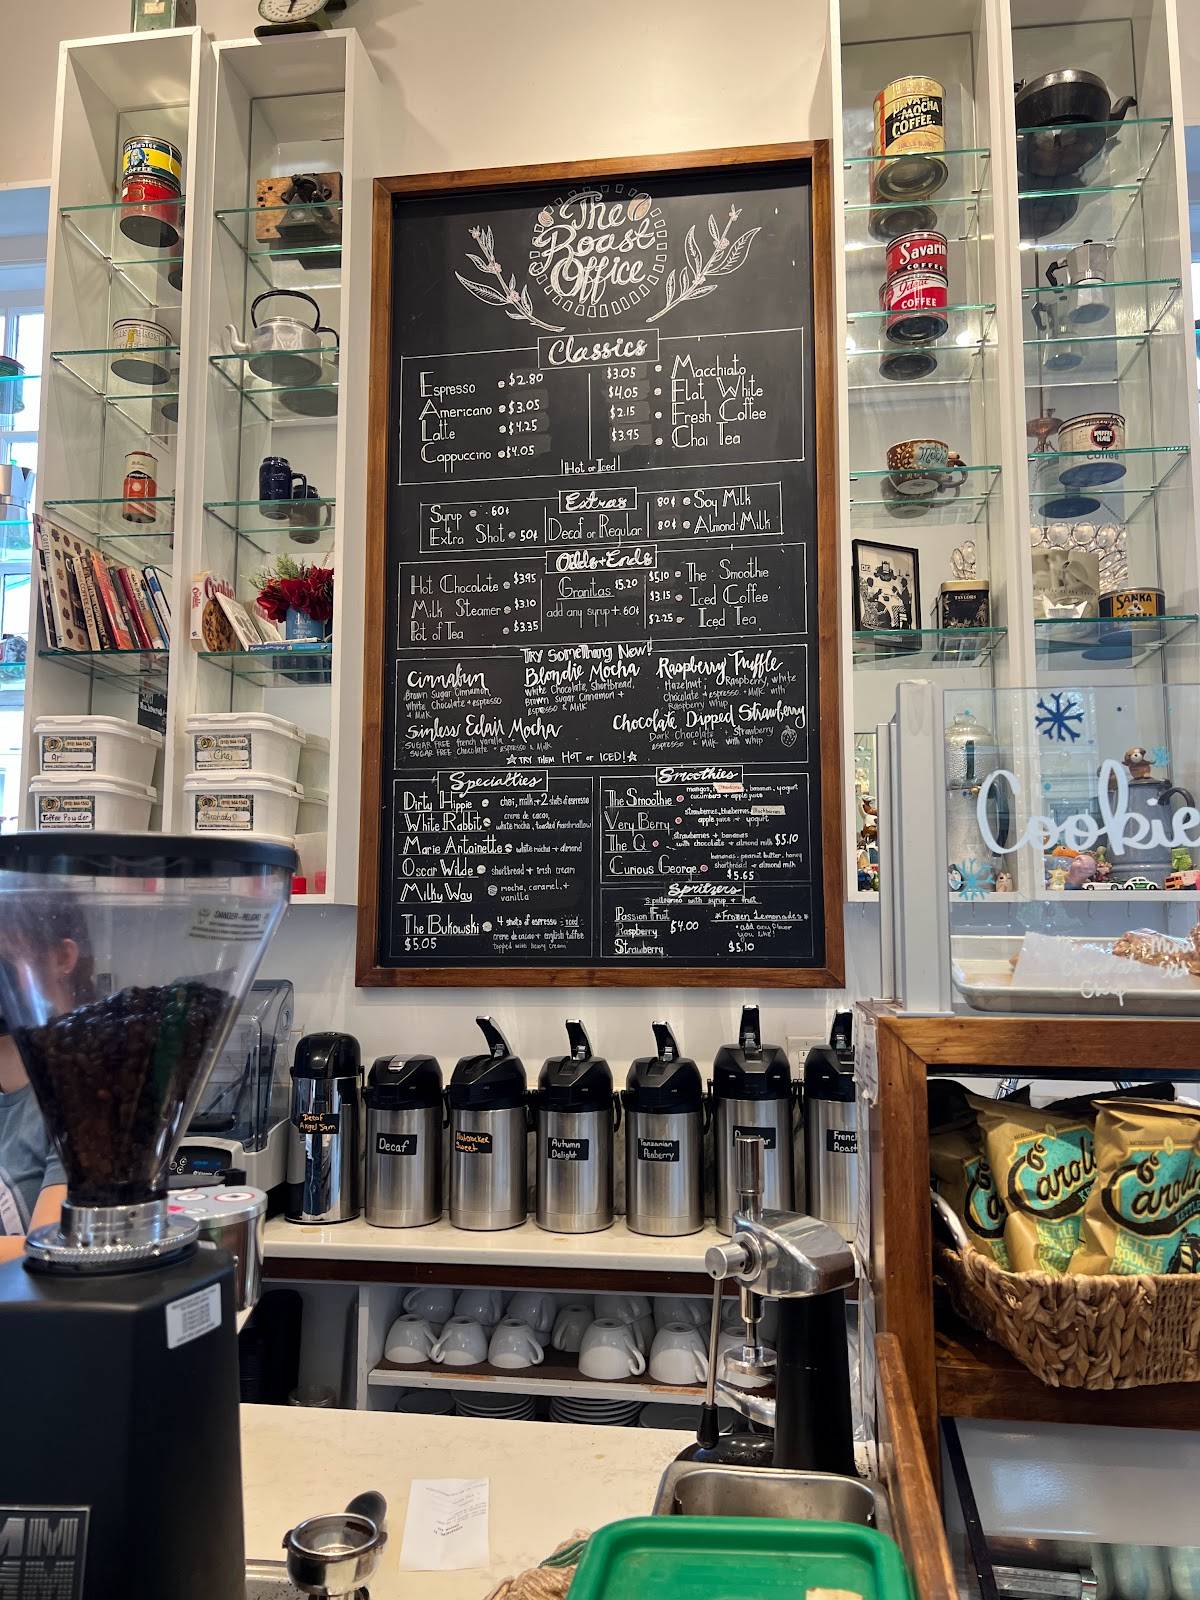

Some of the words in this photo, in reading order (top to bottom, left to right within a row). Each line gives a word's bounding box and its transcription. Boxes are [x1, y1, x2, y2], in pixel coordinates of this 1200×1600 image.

[901, 101, 939, 120] MOCHA
[560, 190, 626, 230] The
[530, 218, 658, 276] Roast
[900, 242, 946, 265] Savarin
[907, 263, 943, 271] COFFEE
[550, 254, 649, 304] Office
[901, 298, 937, 309] COFFEE
[548, 335, 648, 366] Classics
[606, 366, 636, 381] $3.05
[671, 353, 747, 379] Macchiato
[419, 371, 476, 403] Espresso
[509, 372, 543, 387] $2.80
[608, 386, 638, 399] $4.05
[671, 377, 705, 402] Flat
[716, 375, 764, 398] White
[419, 399, 493, 420] Americano
[508, 399, 540, 415] $3.05
[610, 405, 635, 420] $2.15
[671, 400, 712, 425] Fresh
[719, 397, 767, 422] Coffee
[421, 419, 456, 442] Latte
[509, 418, 538, 435] $4.25
[611, 428, 640, 442] $3.95
[671, 424, 708, 448] Chai
[716, 421, 741, 446] Tea
[421, 442, 492, 473] Cappuccino
[506, 445, 535, 459] $4.05
[565, 460, 585, 474] Hot
[596, 457, 616, 472] Iced
[565, 490, 628, 511] Extras
[694, 488, 718, 518] Soy
[722, 486, 751, 508] Milk
[430, 505, 463, 533] Syrup
[694, 512, 736, 534] Almond
[740, 510, 771, 531] Milk
[429, 526, 464, 546] Extra
[475, 523, 505, 544] Shot
[548, 517, 584, 541] Decaf
[586, 530, 596, 538] or
[599, 513, 642, 547] Regular
[685, 562, 707, 582] The
[719, 556, 769, 580] Smoothie
[410, 574, 433, 595] Hot
[440, 573, 499, 594] Chocolate
[513, 572, 537, 585] $3.95
[558, 576, 612, 598] Granitas
[615, 578, 638, 591] $5.20
[650, 590, 671, 602] $3.15
[689, 584, 717, 607] Iced
[723, 583, 769, 605] Coffee
[1116, 593, 1152, 610] SANKA
[410, 599, 443, 619] Milk
[455, 598, 501, 618] Steamer
[514, 598, 537, 611] $3.10
[546, 602, 563, 618] add
[566, 608, 583, 628] any
[587, 606, 610, 628] syrup
[649, 613, 674, 625] $2.25
[698, 607, 726, 628] Iced
[734, 606, 757, 625] Tea
[410, 621, 427, 642] Pot
[432, 622, 442, 640] of
[444, 621, 464, 640] Tea
[514, 621, 539, 633] $3.35
[407, 663, 488, 690] Cinnabun
[524, 660, 584, 687] Blondie
[589, 660, 640, 682] Mocha
[656, 656, 727, 685] Raspberry
[728, 650, 783, 678] Truffle
[431, 697, 465, 710] Chocolate
[668, 700, 705, 711] Raspberry
[613, 708, 677, 732] Chocolate
[686, 705, 736, 731] Dipped
[738, 700, 806, 729] Strawberry
[405, 717, 461, 741] Sinless
[466, 714, 505, 737] Eclair
[508, 717, 563, 743] Mocha
[519, 756, 532, 764] TRY
[449, 771, 543, 798] Specialties
[658, 767, 739, 784] Smoothies
[403, 791, 433, 811] Dirty
[439, 790, 472, 812] Hippie
[540, 793, 548, 806] 2
[604, 789, 625, 807] The
[626, 787, 673, 806] Smoothie
[63, 813, 89, 822] Powder
[404, 813, 439, 832] White
[442, 812, 482, 831] Rabbit
[604, 811, 635, 835] Very
[638, 812, 670, 835] Berry
[403, 836, 441, 855] Marie
[445, 834, 503, 855] Antoinette
[605, 835, 627, 852] The
[633, 834, 646, 851] Q
[775, 834, 798, 846] $5.10
[402, 857, 437, 877] Oscar
[440, 857, 473, 877] Wilde
[610, 855, 654, 875] Curious
[727, 868, 754, 880] $5.65
[400, 882, 443, 903] Milky
[444, 882, 472, 903] Way
[668, 883, 742, 900] Spritzers
[400, 914, 425, 934] The
[428, 913, 480, 934] Bukowski
[615, 906, 647, 921] Passion
[650, 907, 670, 920] Fruit
[721, 910, 750, 921] Frozen
[615, 922, 658, 938] Raspberry
[670, 921, 699, 934] $4.00
[404, 938, 437, 951] $5.05
[615, 938, 664, 955] Strawberry
[728, 941, 754, 953] $5.10
[379, 1138, 410, 1152] Decaf
[551, 1138, 581, 1149] Autumn
[551, 1149, 578, 1160] Delight
[643, 1150, 675, 1161] Peaberry
